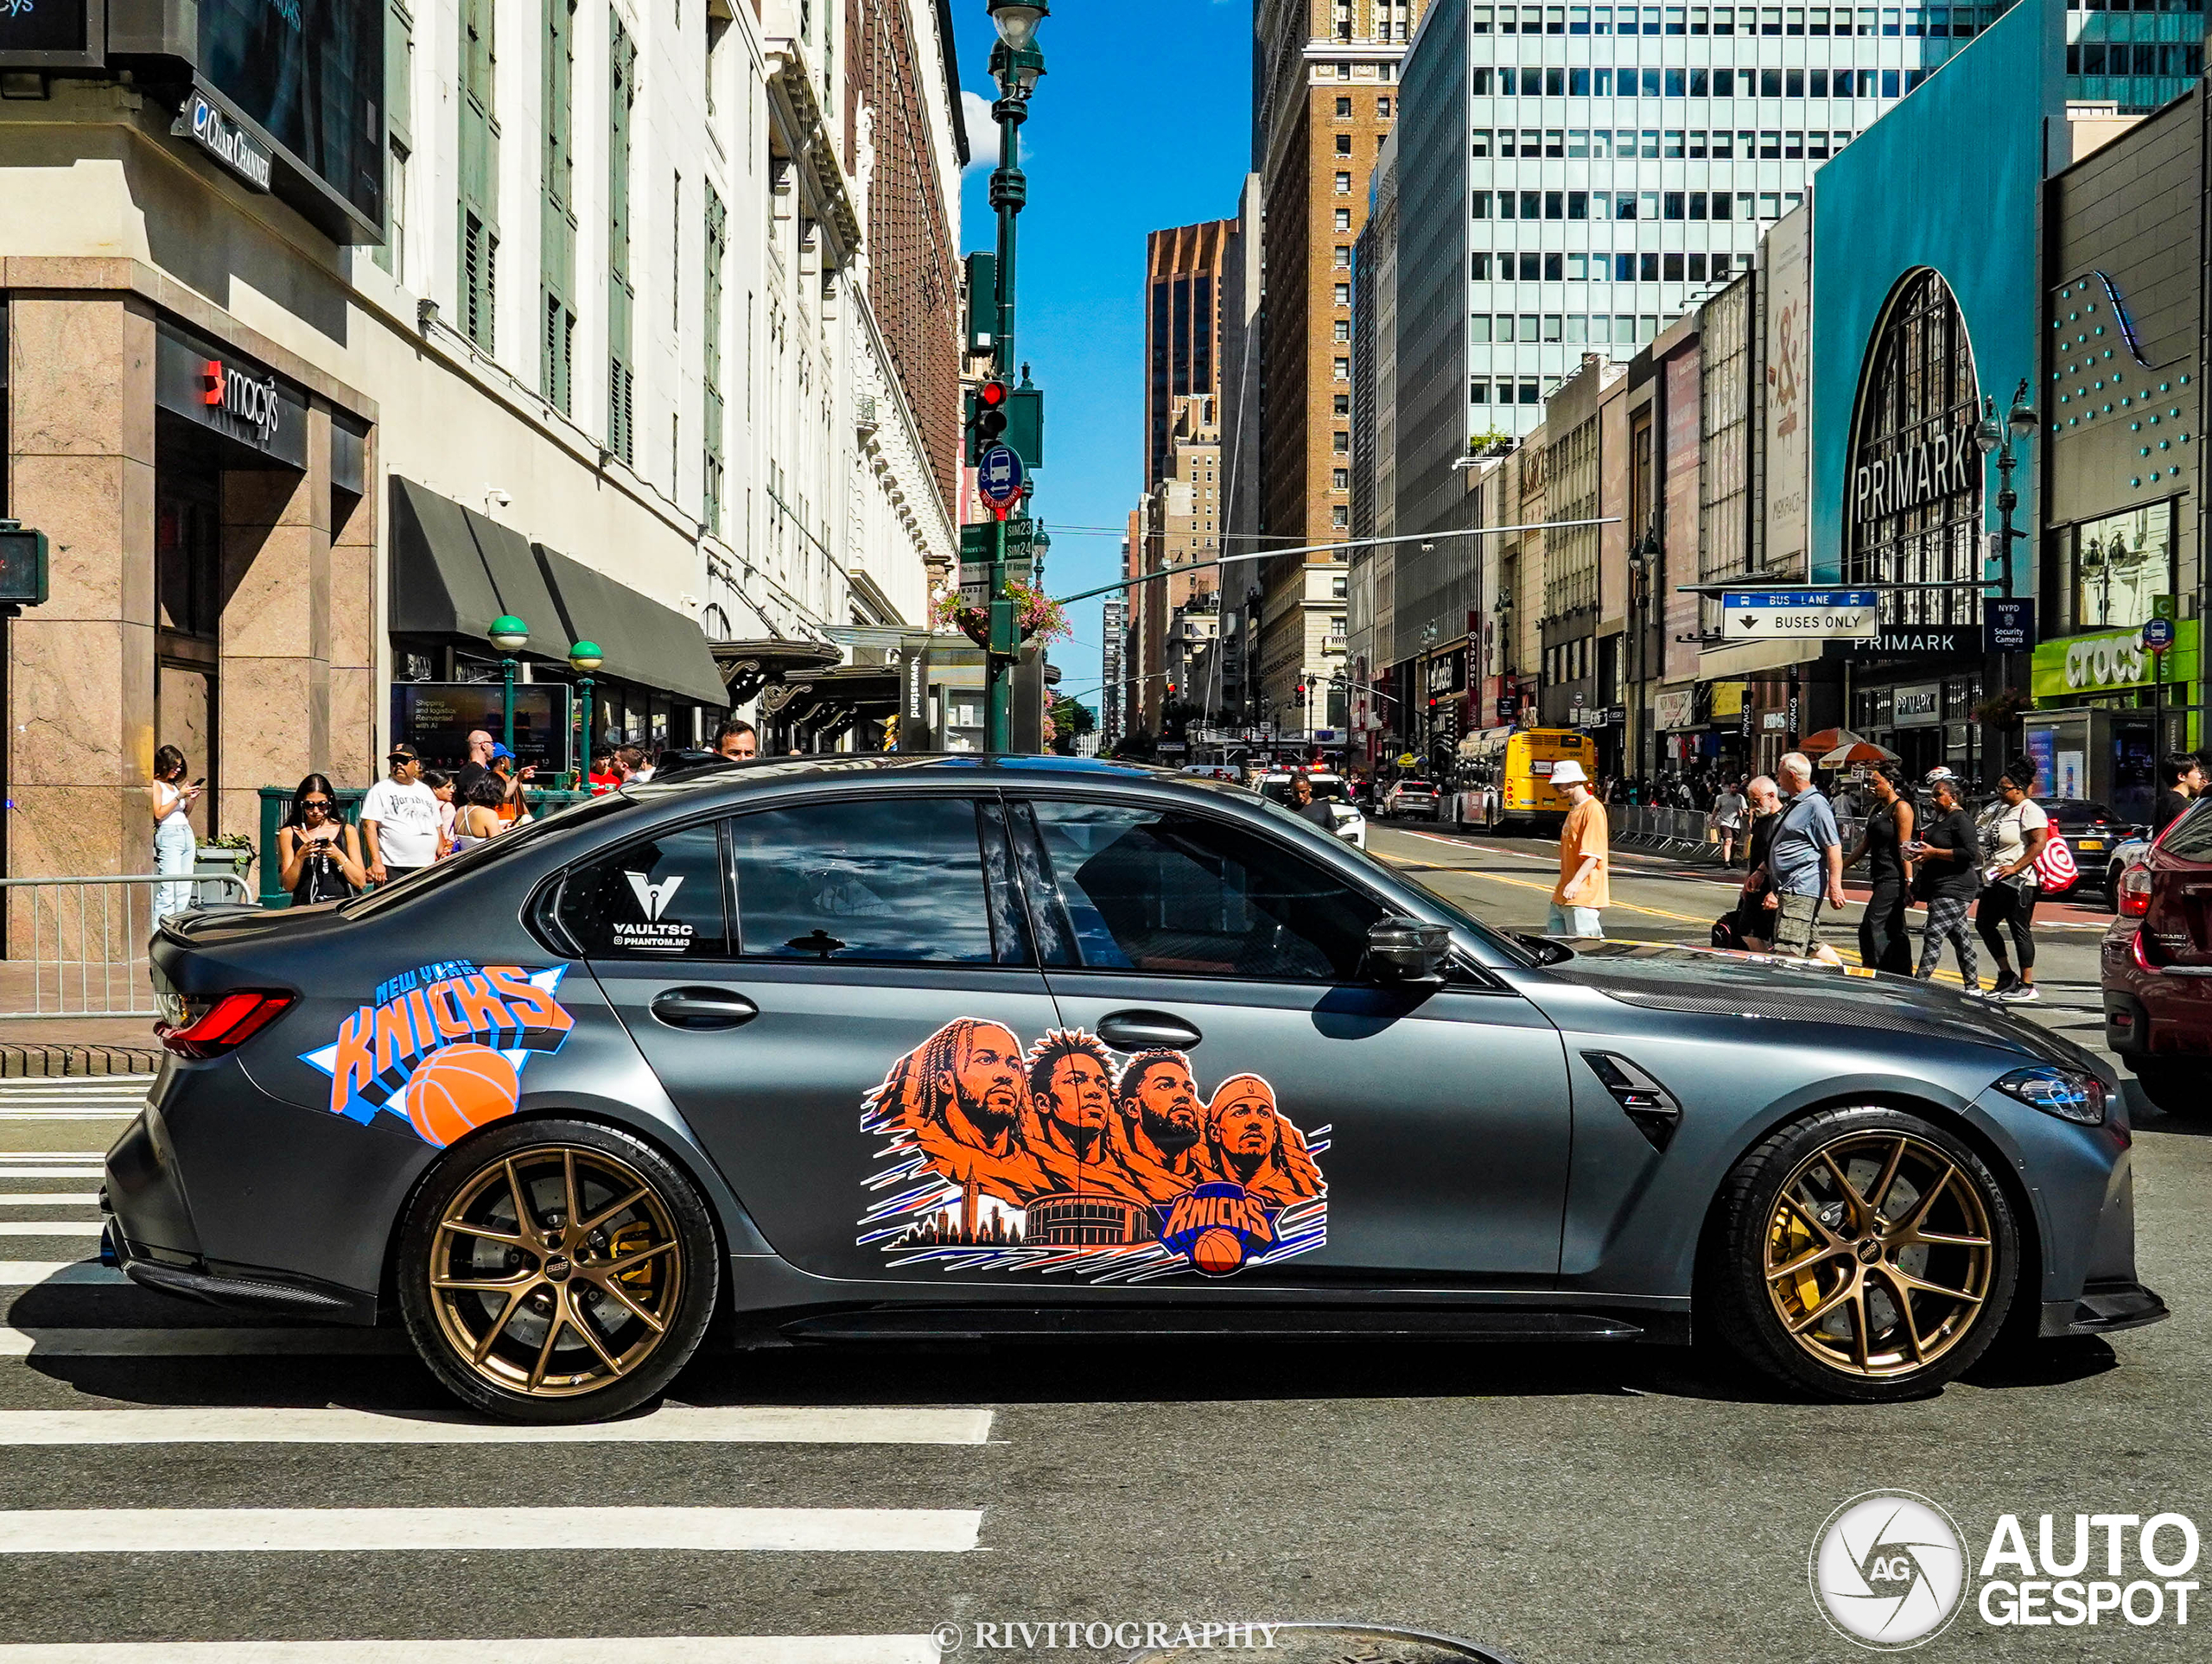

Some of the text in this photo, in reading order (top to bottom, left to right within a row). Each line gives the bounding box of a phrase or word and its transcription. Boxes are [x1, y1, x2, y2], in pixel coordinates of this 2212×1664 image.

[1858, 424, 1967, 524] PRIMARK
[989, 489, 1018, 508] STANDING
[1007, 521, 1032, 537] SIM23
[1007, 541, 1032, 556] SIM24
[1769, 595, 1829, 605] BUS LANE
[1775, 615, 1861, 628] BUSES ONLY
[1994, 627, 2024, 637] Security
[1995, 635, 2024, 644] Camera
[1853, 634, 1955, 651] PRIMARK
[2066, 633, 2144, 689] crocs
[910, 657, 921, 718] Newsstand
[416, 699, 445, 708] Shipping
[624, 937, 690, 946] PHANTOM.M3
[376, 958, 478, 1007] NEW YORK
[331, 965, 576, 1115] KNICKS
[1162, 1195, 1274, 1242] KNICKS
[546, 1261, 569, 1273] BBS
